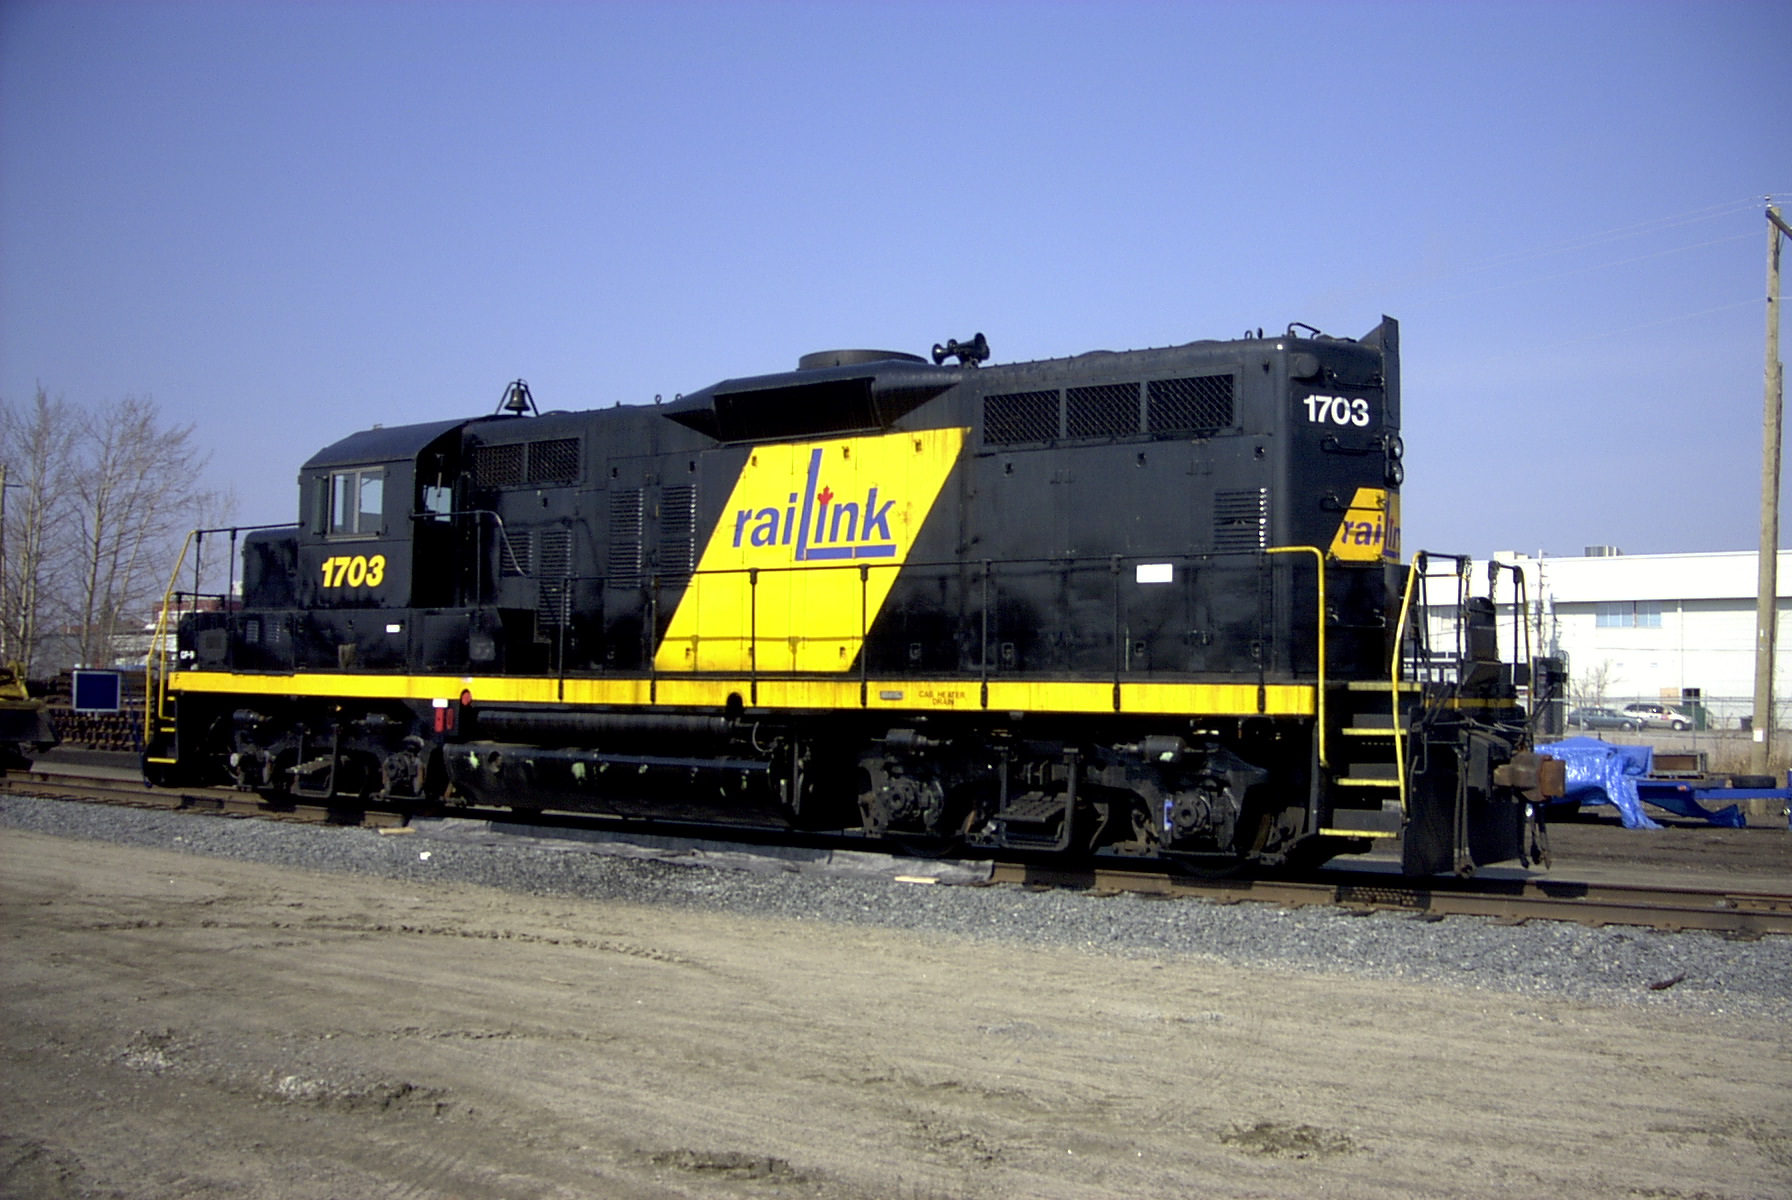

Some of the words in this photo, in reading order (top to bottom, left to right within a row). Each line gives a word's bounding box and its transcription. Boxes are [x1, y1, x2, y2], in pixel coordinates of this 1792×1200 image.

[1303, 394, 1369, 427] 1703
[322, 554, 386, 588] 1703
[938, 691, 966, 699] HEATER
